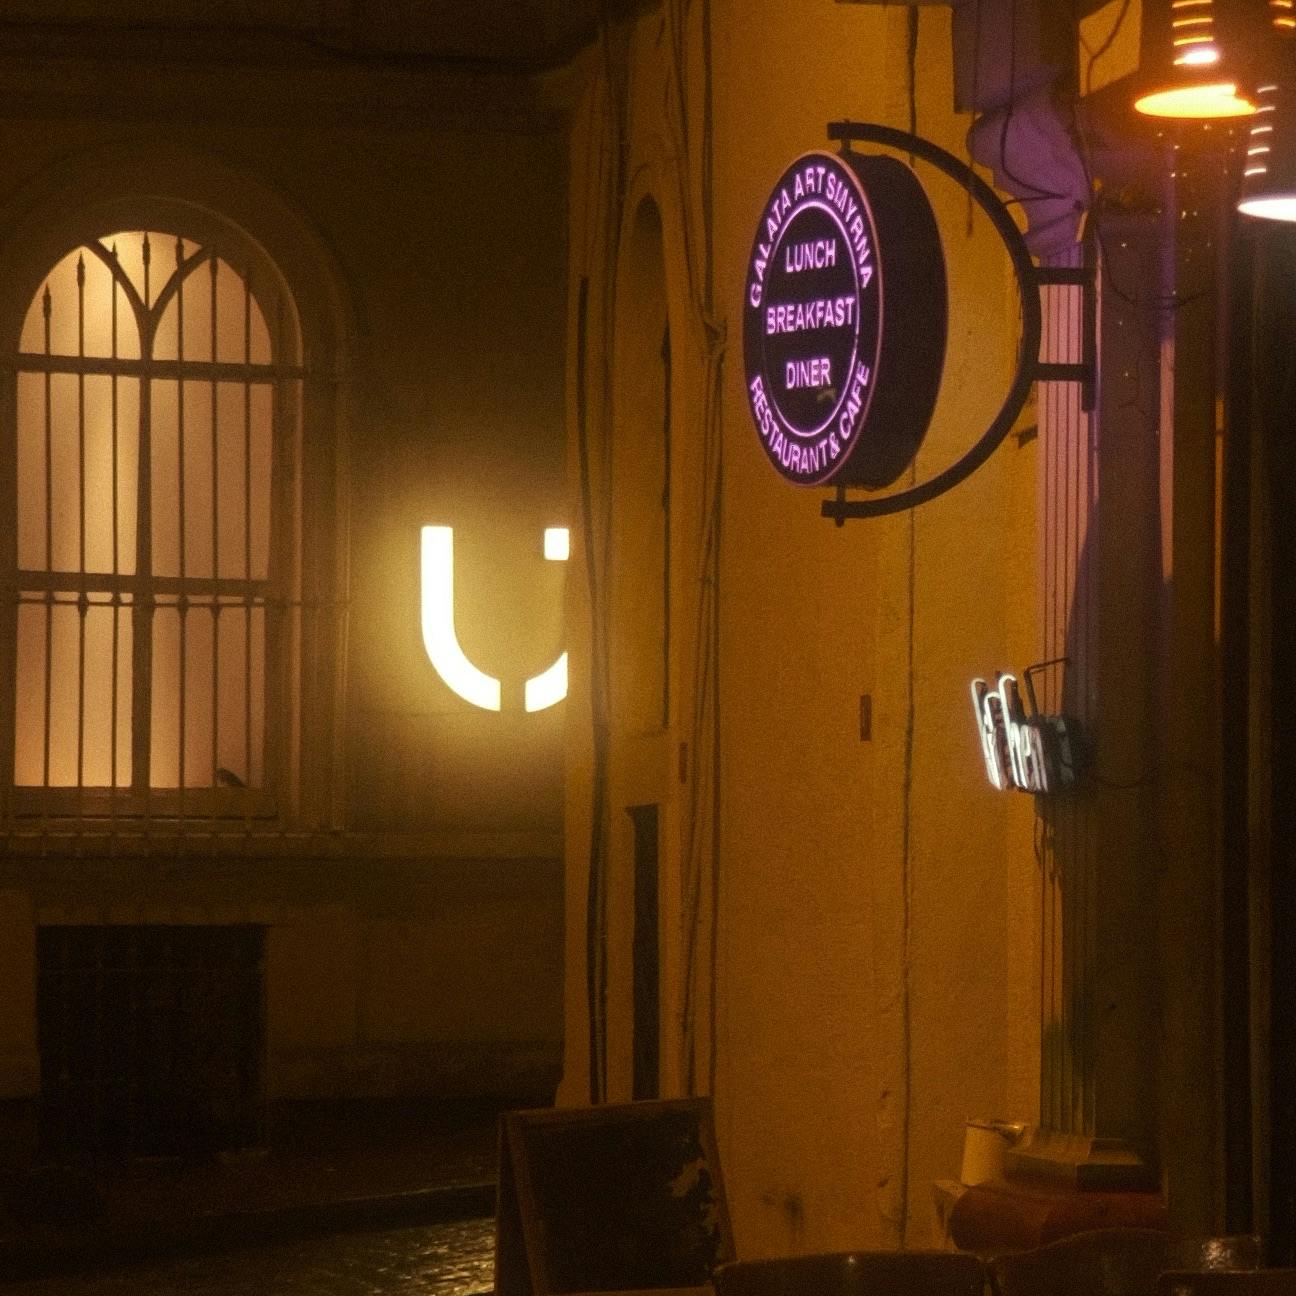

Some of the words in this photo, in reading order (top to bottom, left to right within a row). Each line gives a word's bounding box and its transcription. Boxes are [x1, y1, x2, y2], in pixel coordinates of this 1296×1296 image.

[750, 188, 791, 308] GALATA
[794, 166, 827, 200] ART
[826, 172, 873, 288] SMYRNA
[785, 239, 836, 273] LUNCH
[766, 296, 855, 335] BREAKFAST
[786, 358, 831, 389] DINER
[750, 375, 828, 474] RESTAURANT
[829, 432, 841, 460] &
[839, 361, 870, 440] CAFE
